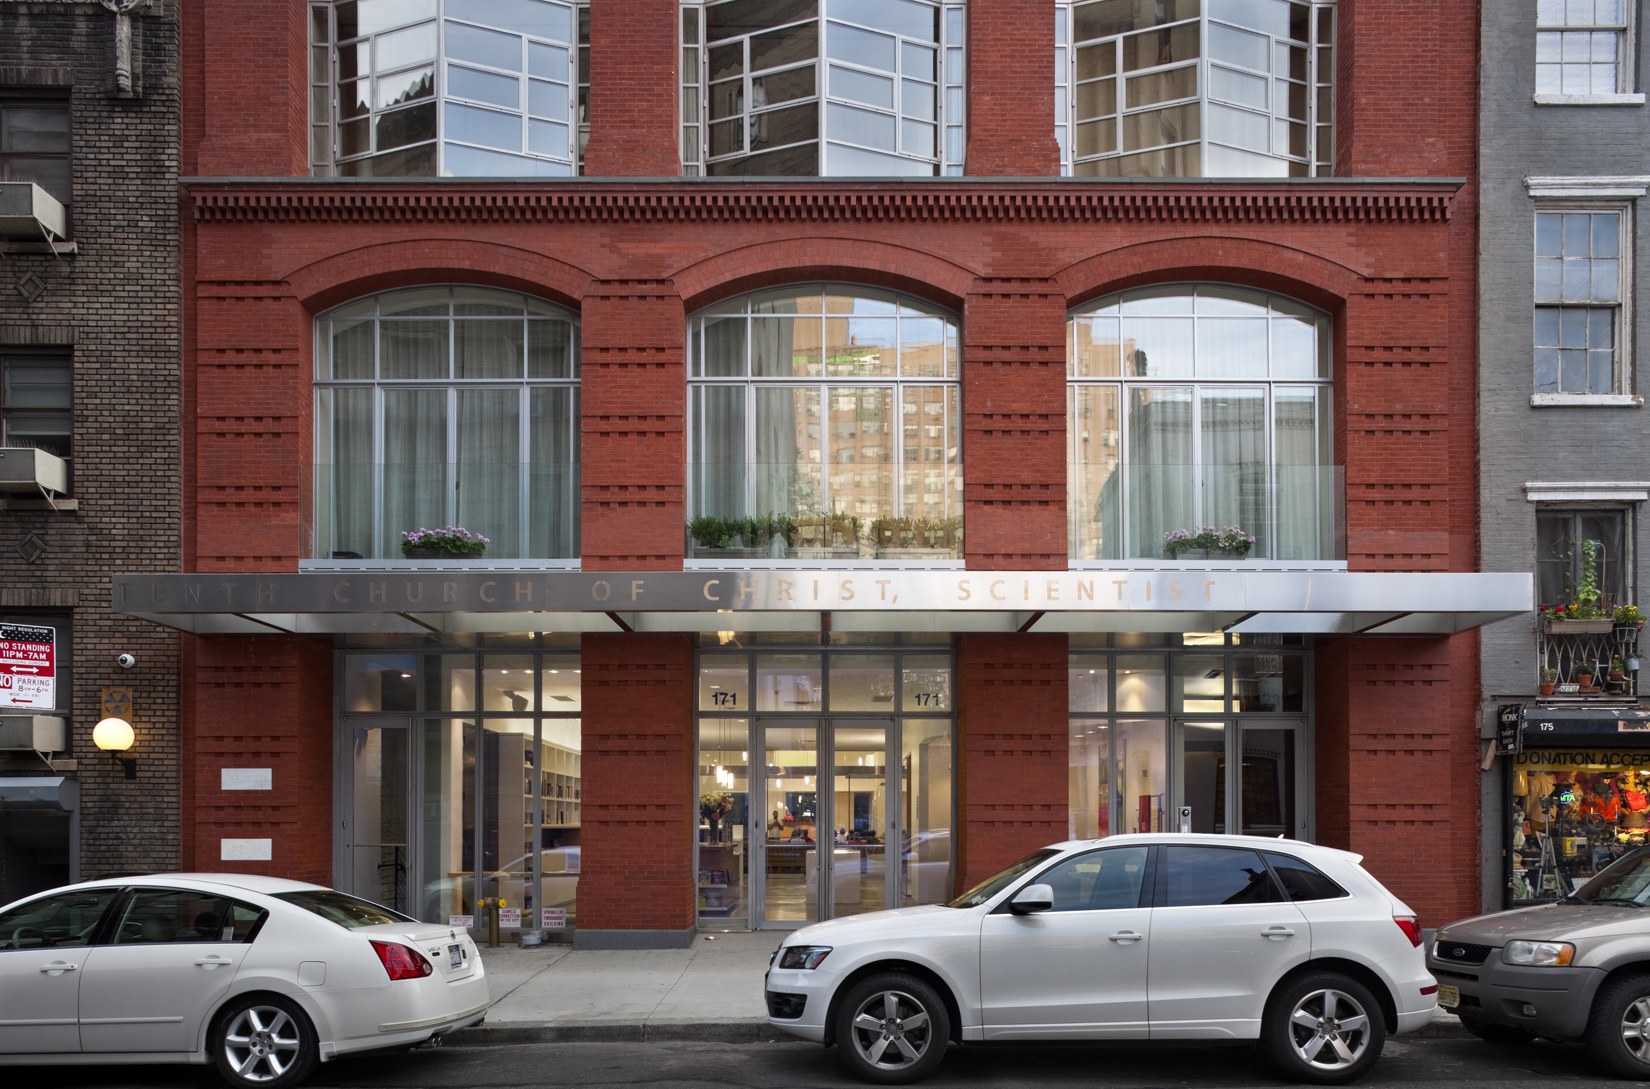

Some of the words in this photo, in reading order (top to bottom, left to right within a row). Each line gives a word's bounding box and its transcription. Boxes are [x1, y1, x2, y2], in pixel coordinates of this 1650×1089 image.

[117, 582, 276, 604] TENTH
[333, 580, 534, 603] CHURCH
[591, 580, 645, 602] OF
[702, 579, 899, 604] CHRIST,
[957, 579, 1216, 602] SCIENTIST
[12, 642, 51, 653] STANDING
[2, 650, 47, 660] 11PM-7AM
[17, 678, 50, 687] PARKING
[711, 692, 737, 706] 171
[914, 692, 940, 706] 171
[1540, 722, 1554, 731] 175
[1516, 751, 1596, 765] DONATION
[1600, 752, 1650, 767] ACCEP
